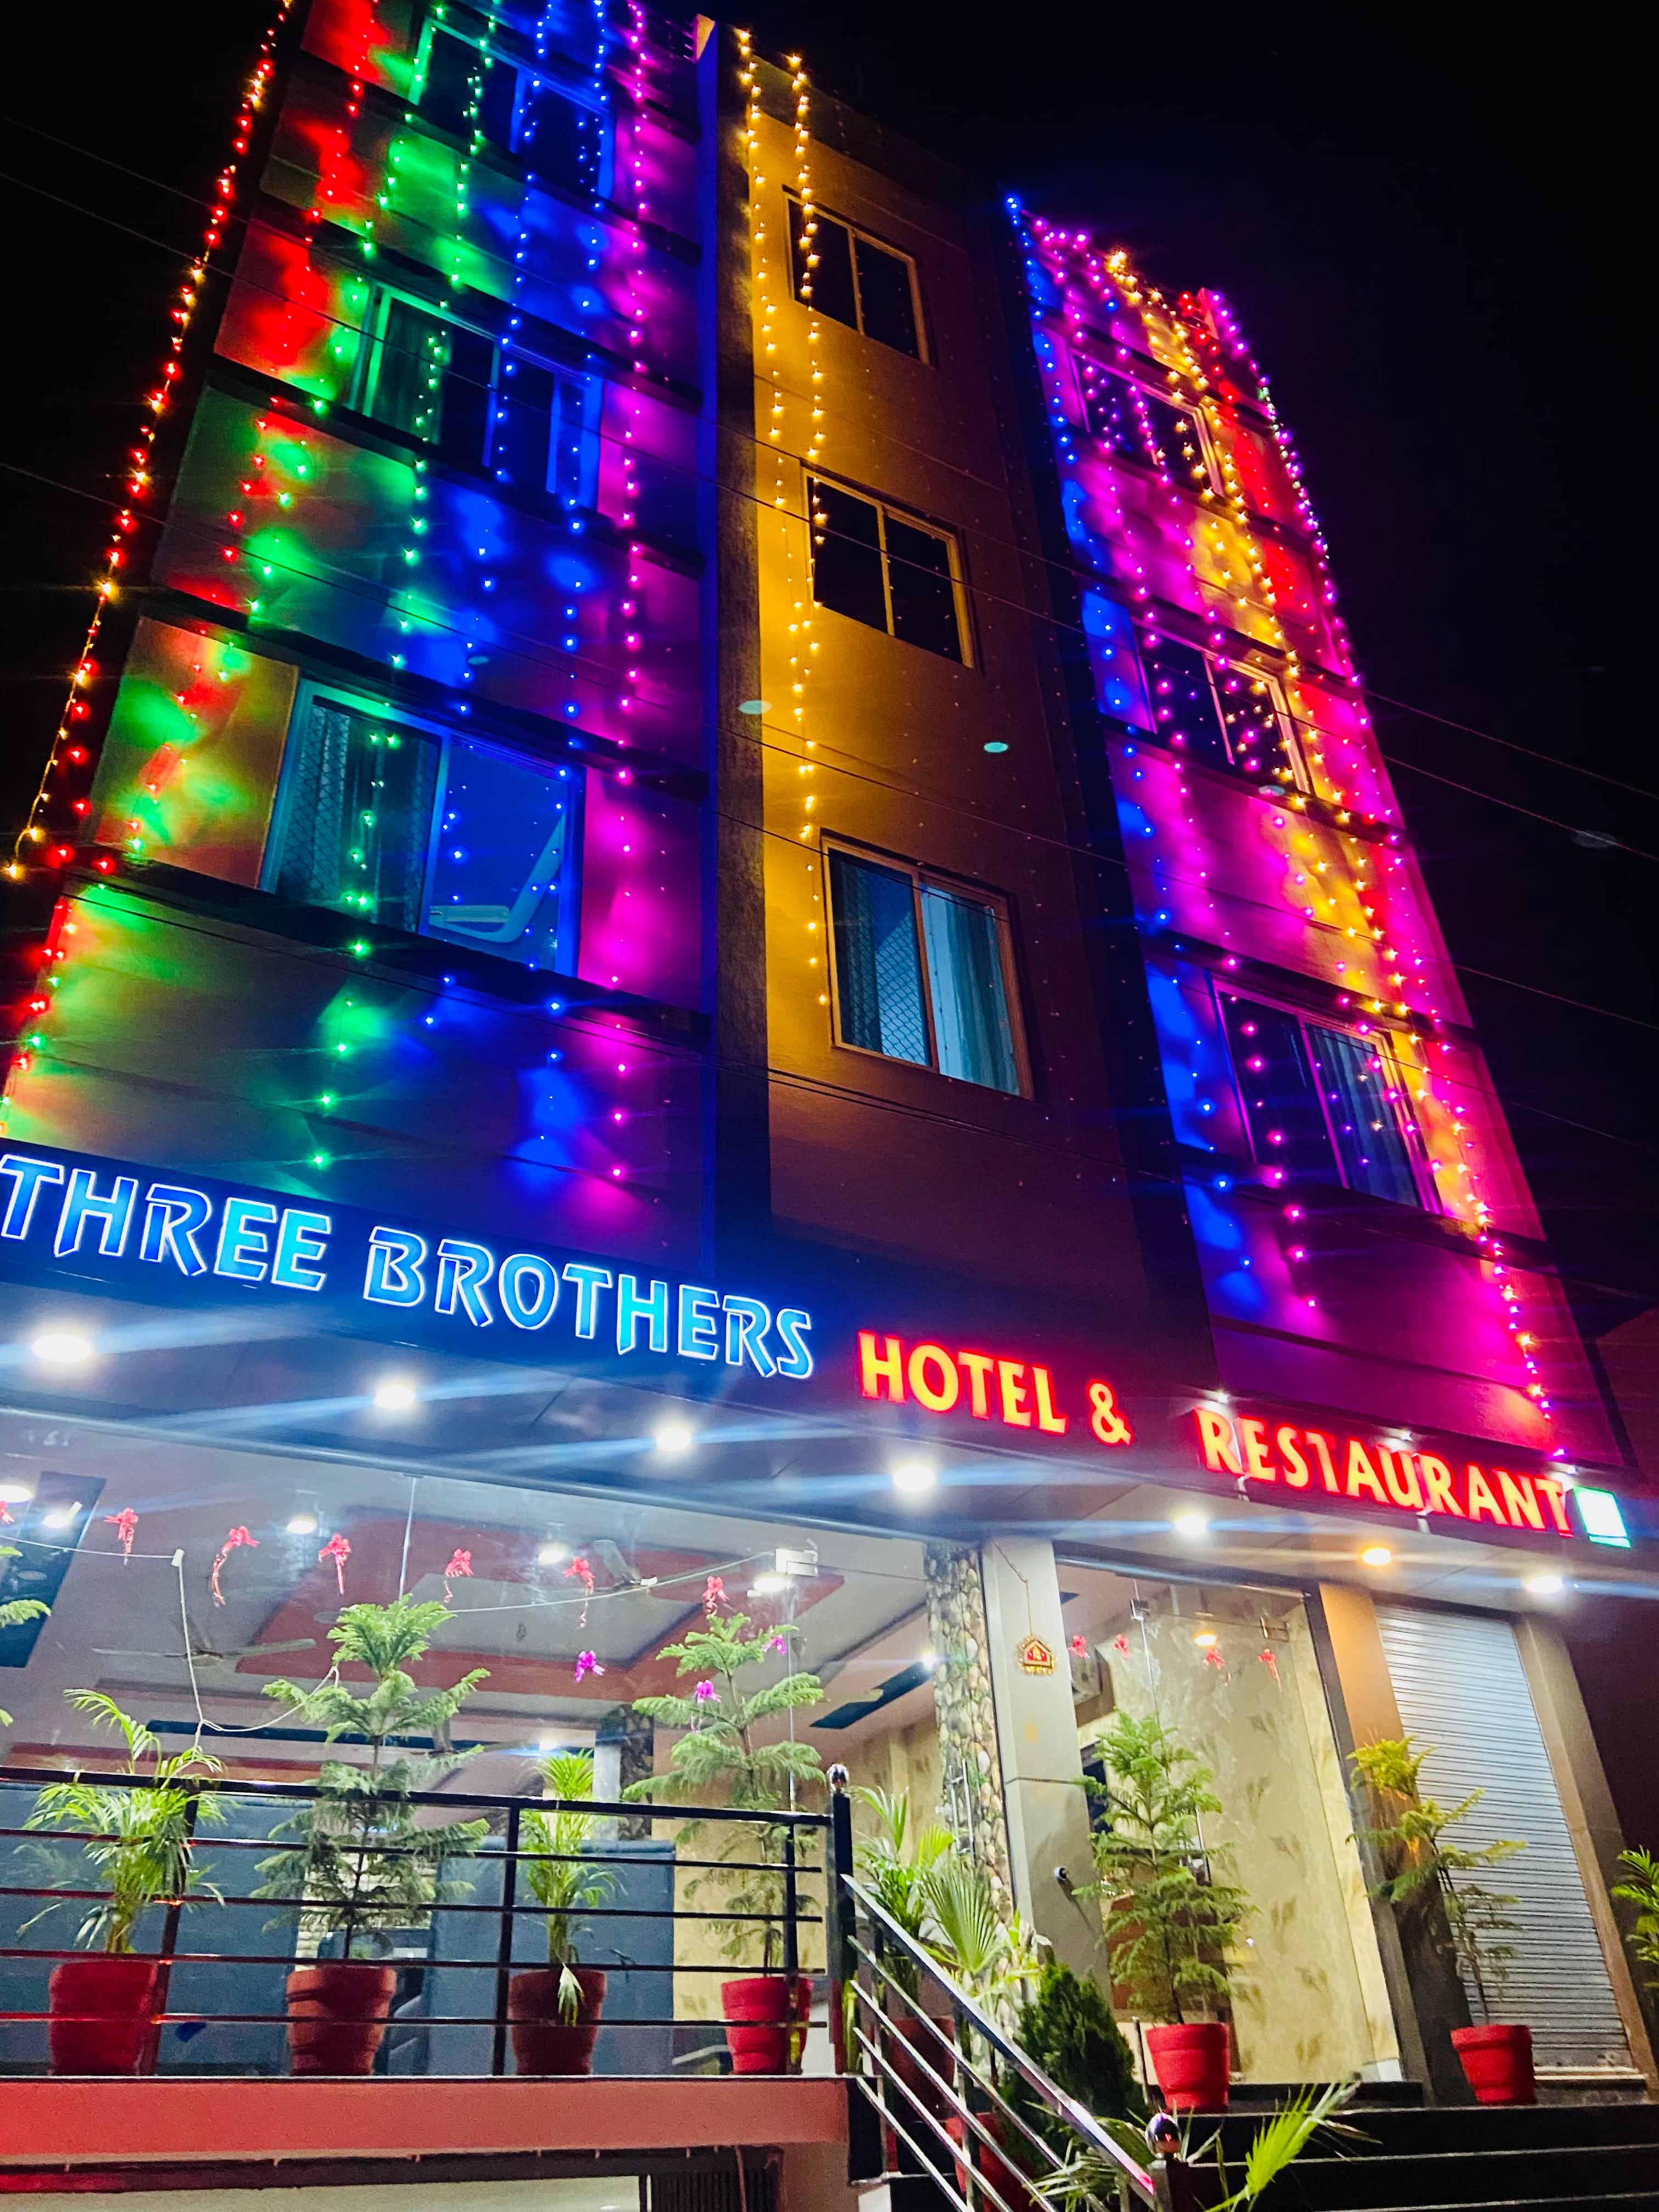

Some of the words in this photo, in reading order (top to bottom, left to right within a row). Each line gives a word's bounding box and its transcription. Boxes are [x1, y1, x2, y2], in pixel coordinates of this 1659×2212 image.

[0, 1153, 331, 1291] THREE
[363, 1226, 814, 1379] BROTHERS
[858, 1329, 1068, 1435] HOTEL
[1087, 1378, 1133, 1447] &
[1194, 1407, 1575, 1538] RESTAURANT
